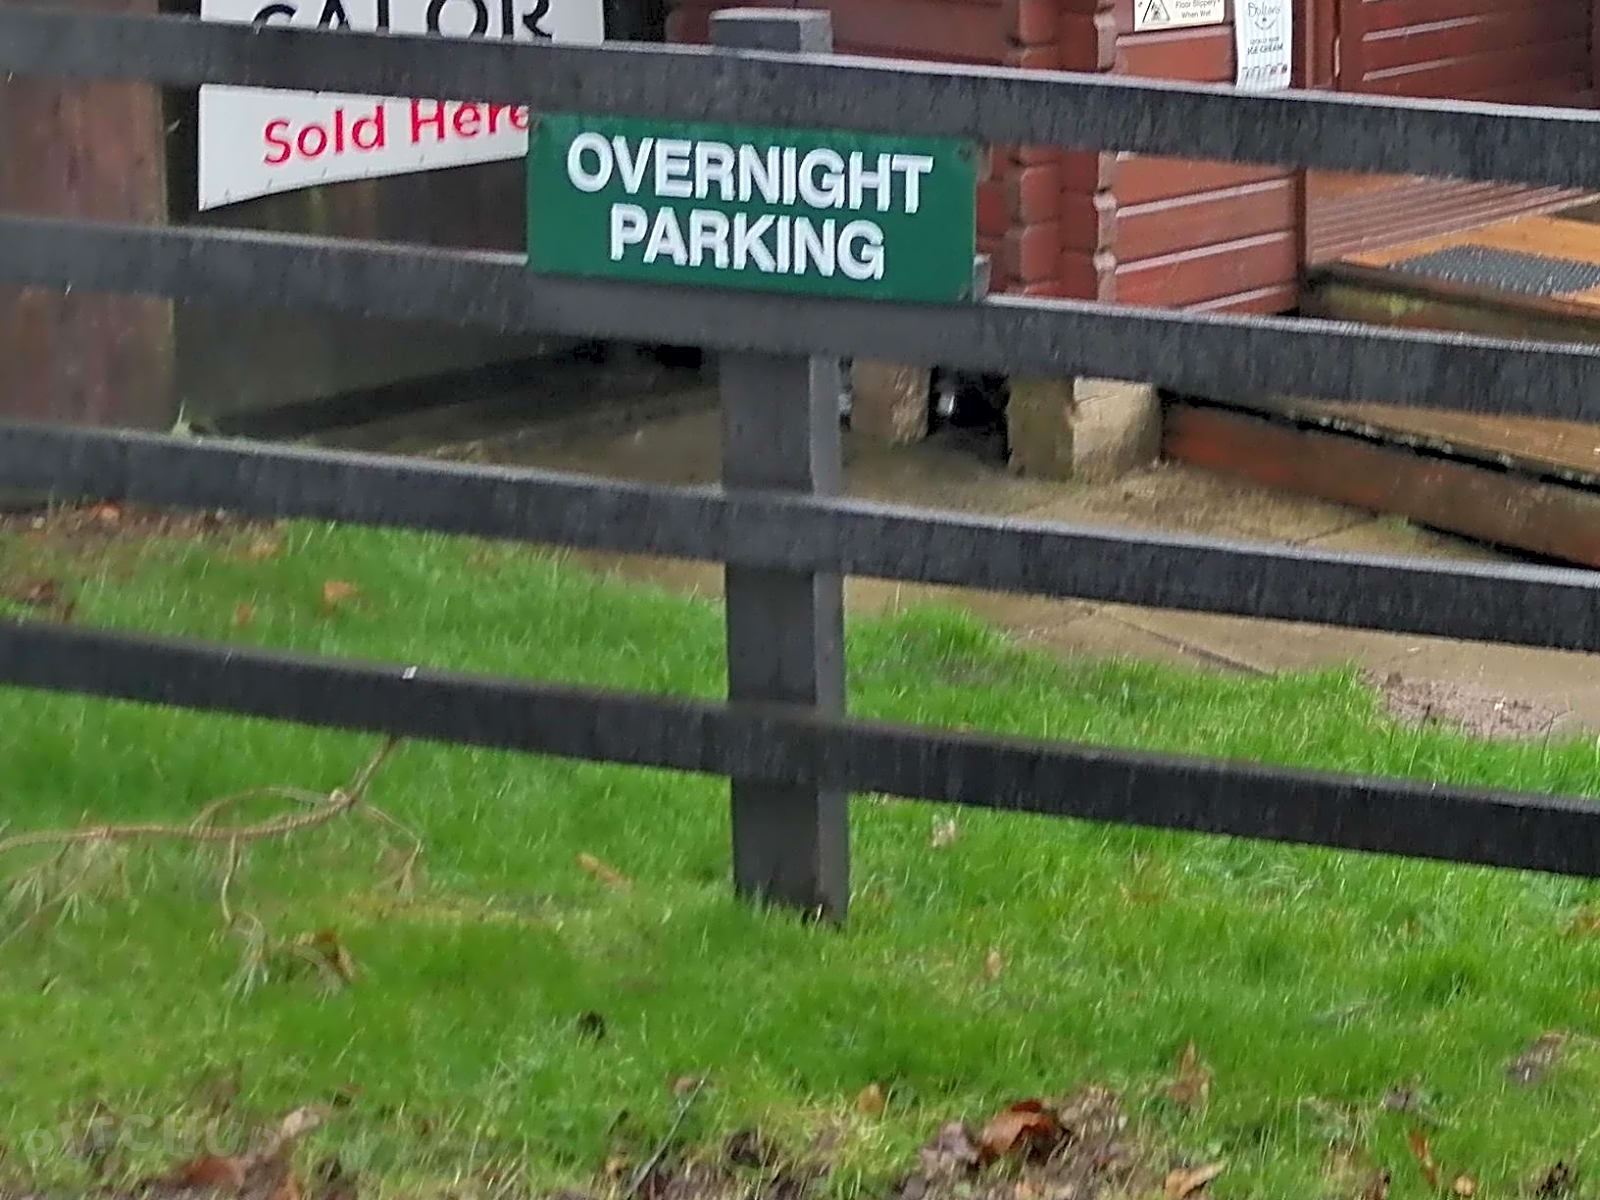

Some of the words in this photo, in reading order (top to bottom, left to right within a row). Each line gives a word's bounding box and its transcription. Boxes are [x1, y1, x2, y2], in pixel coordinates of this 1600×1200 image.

[263, 103, 386, 165] Sold
[567, 131, 935, 214] OVERNIGHT
[610, 202, 886, 281] PARKING
